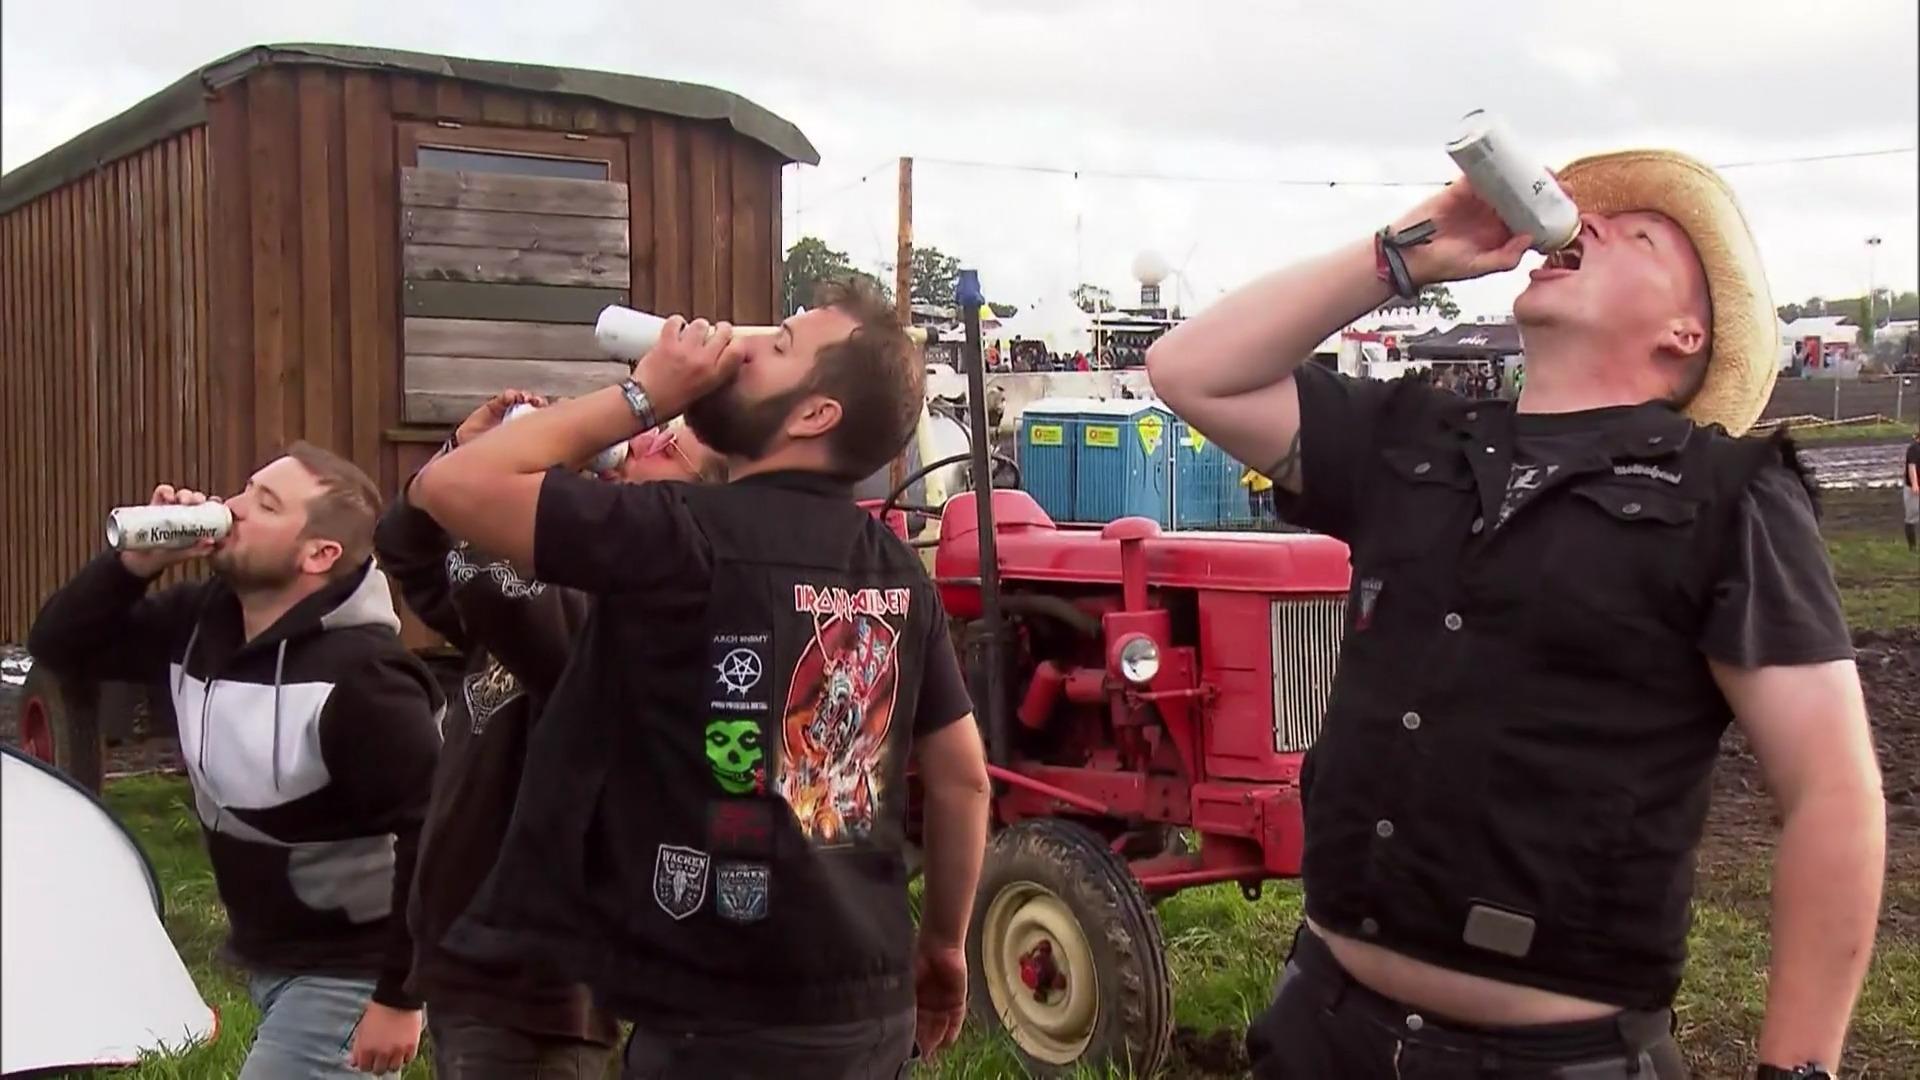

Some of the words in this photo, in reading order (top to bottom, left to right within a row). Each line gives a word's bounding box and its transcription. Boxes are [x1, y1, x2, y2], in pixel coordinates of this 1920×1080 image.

[713, 635, 738, 643] ARCH
[662, 850, 706, 869] WACKEN
[720, 871, 765, 879] WACKEN
